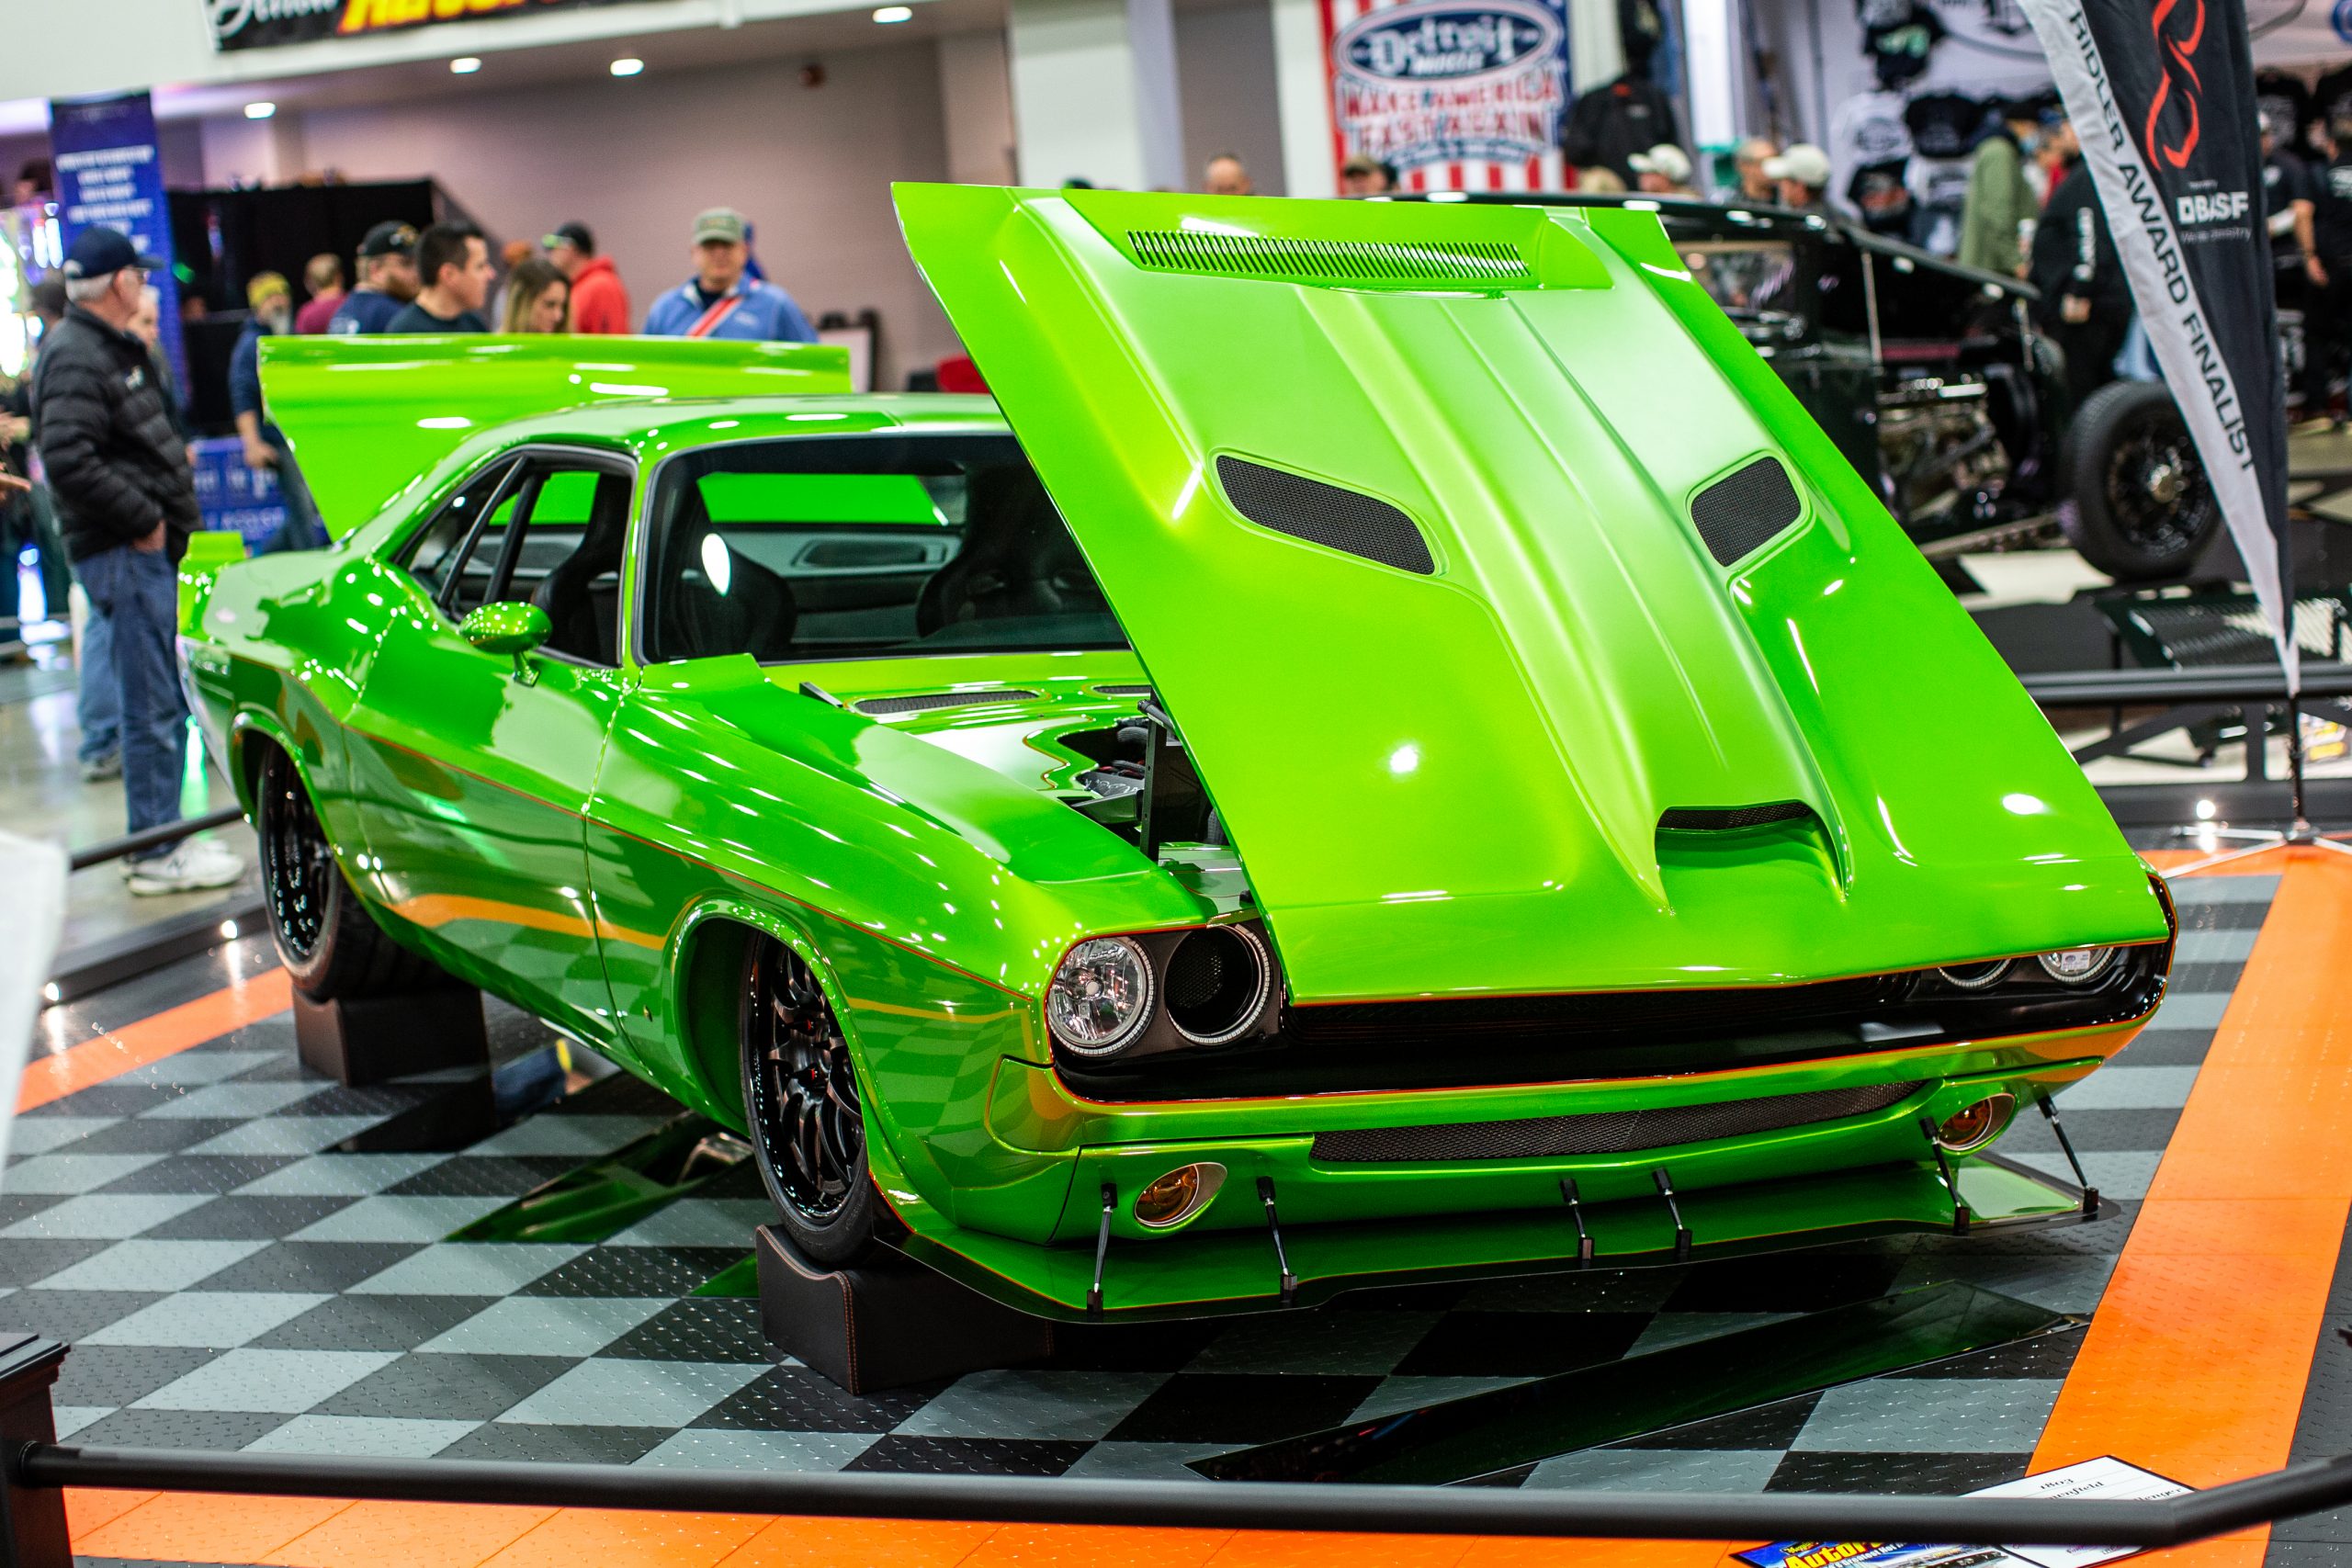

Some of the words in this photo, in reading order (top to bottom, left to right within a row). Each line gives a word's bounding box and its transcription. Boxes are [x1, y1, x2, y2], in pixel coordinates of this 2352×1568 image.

[2068, 10, 2124, 152] RIDLER
[2119, 163, 2188, 305] AWARD
[2181, 311, 2256, 471] FINALIST
